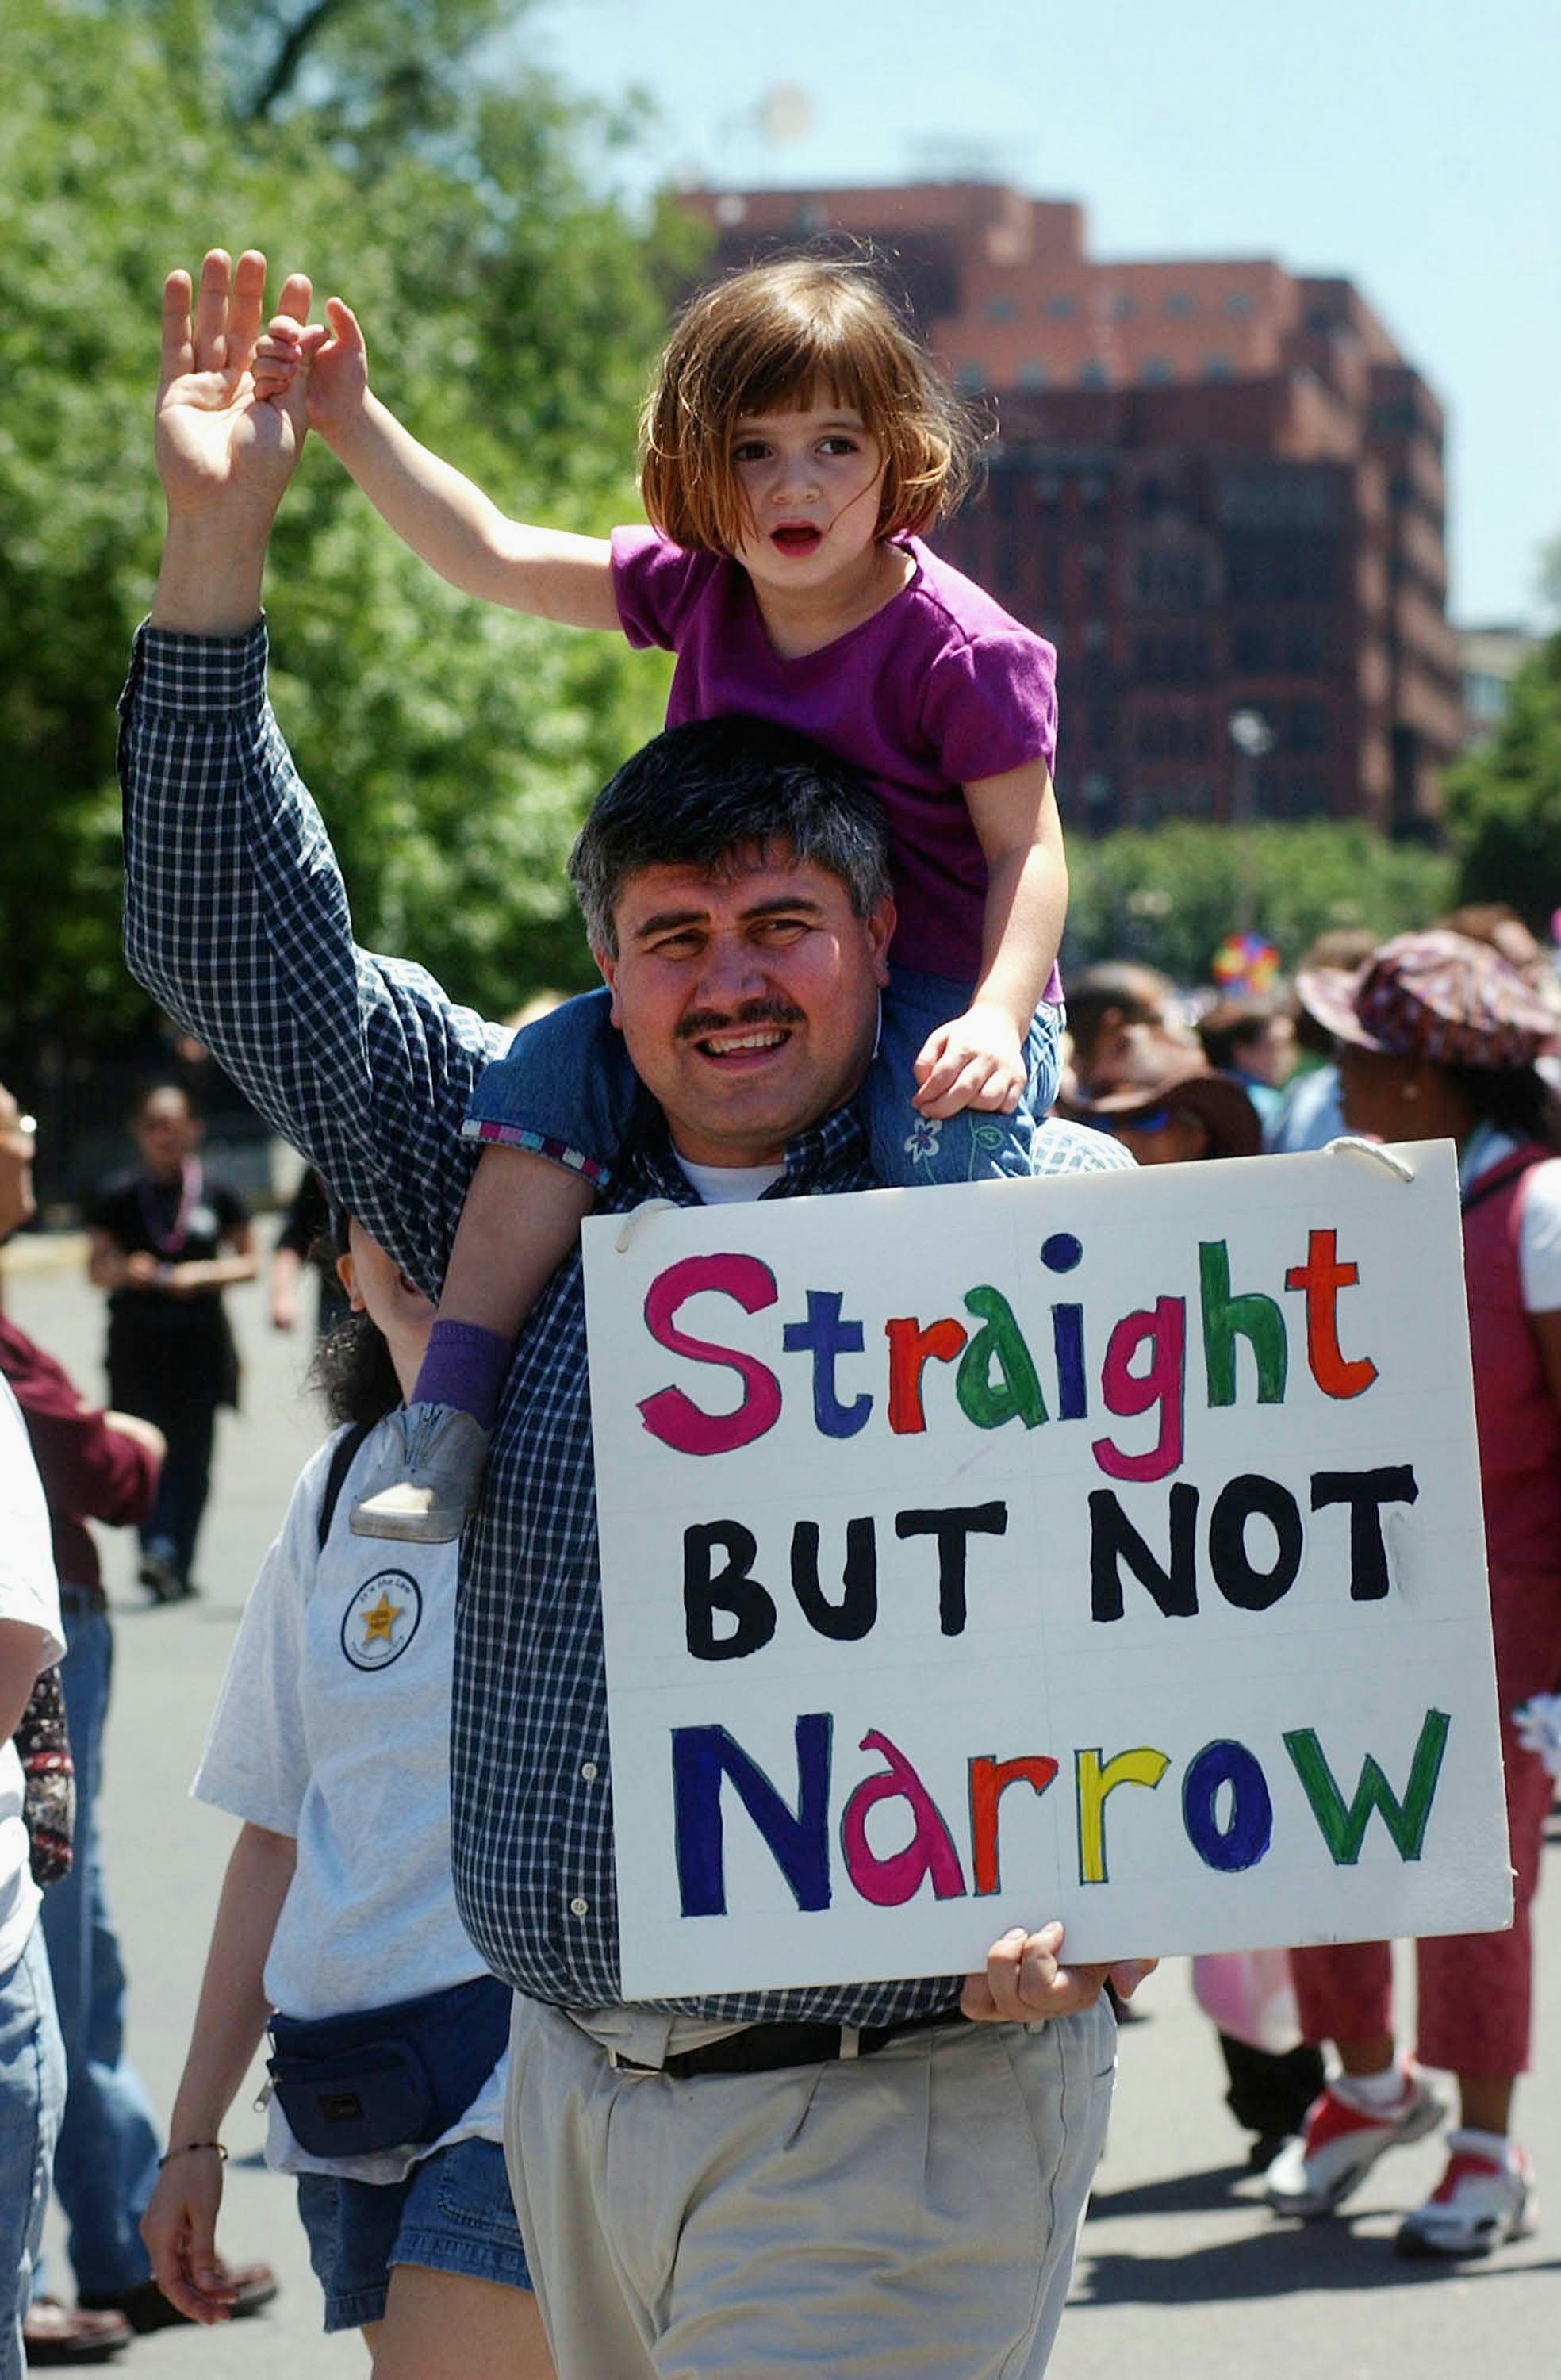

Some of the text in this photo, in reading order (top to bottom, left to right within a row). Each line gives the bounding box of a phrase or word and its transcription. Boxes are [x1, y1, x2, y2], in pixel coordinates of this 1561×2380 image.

[638, 1230, 1379, 1481] Straight
[684, 1465, 1418, 1660] BUT NOT
[670, 1709, 1451, 1917] Narrow
